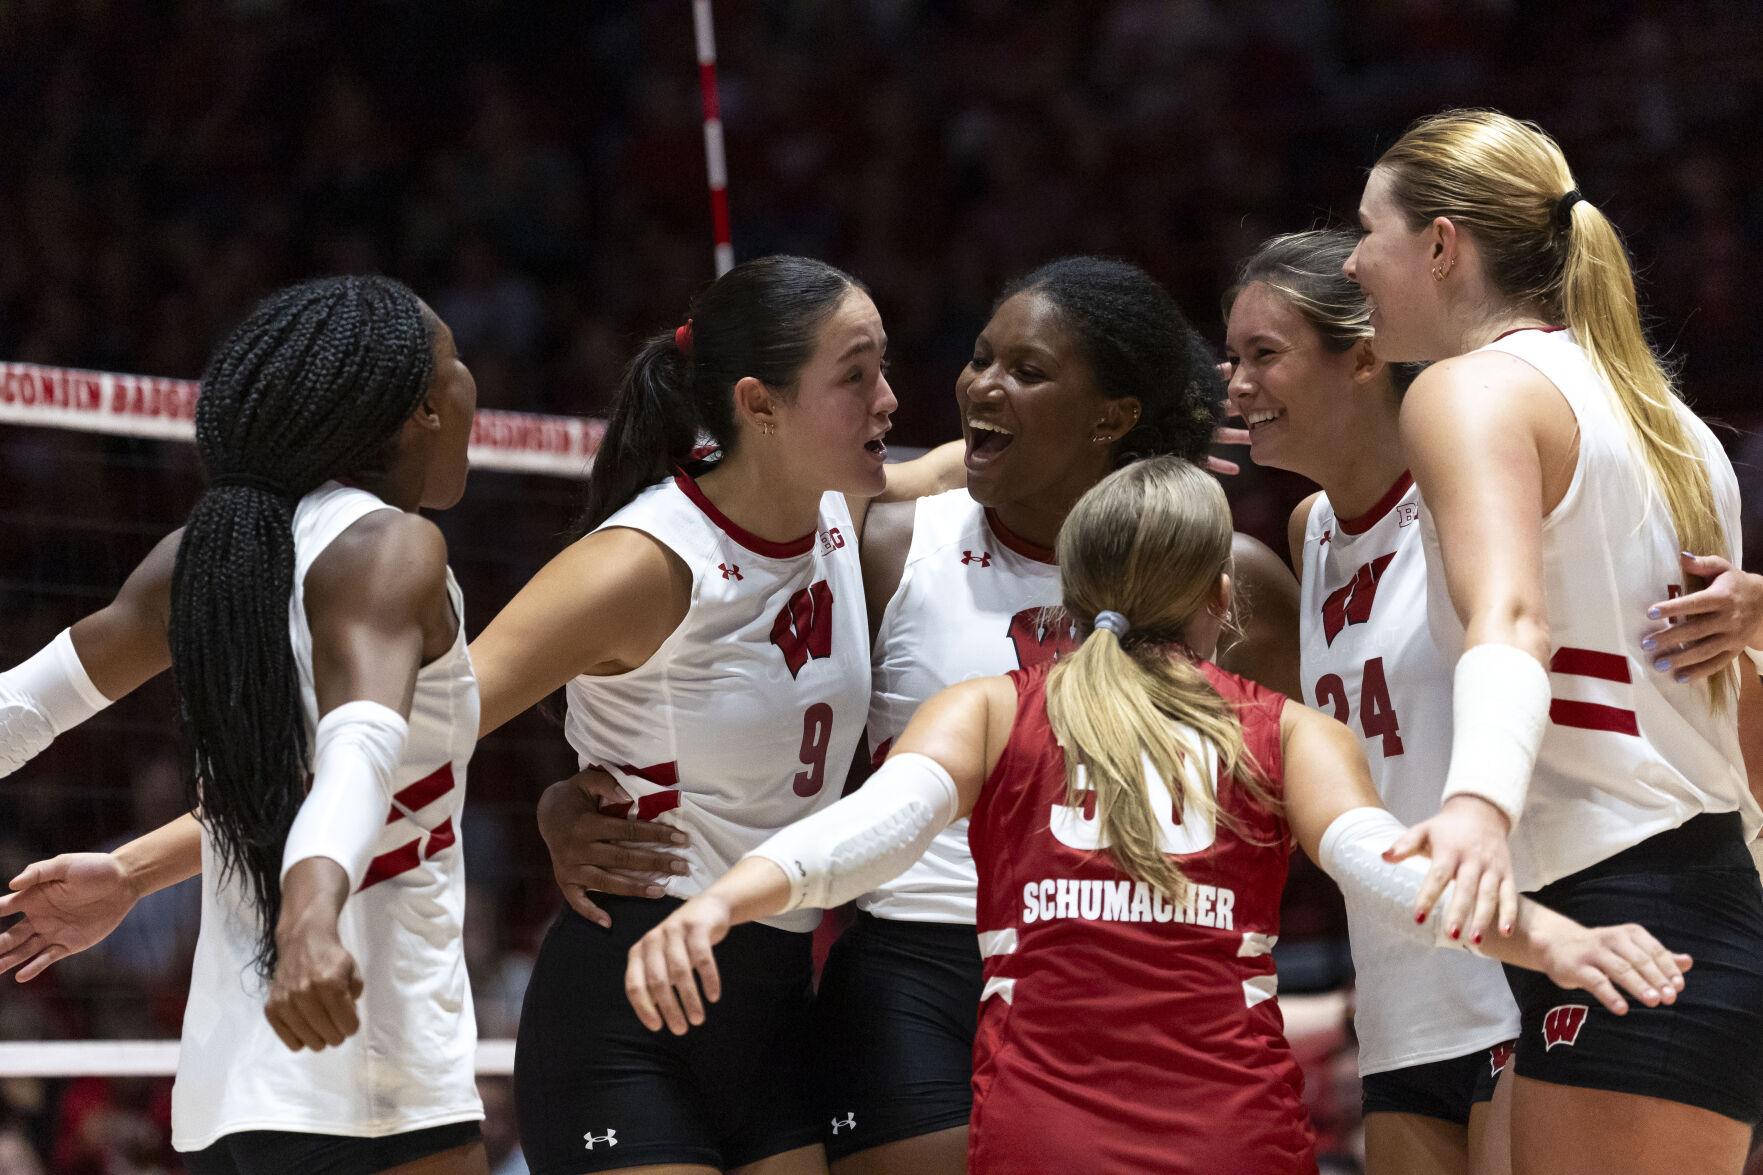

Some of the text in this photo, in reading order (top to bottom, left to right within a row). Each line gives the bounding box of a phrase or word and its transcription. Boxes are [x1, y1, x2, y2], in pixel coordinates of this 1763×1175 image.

[0, 370, 101, 411] CONSIN
[1315, 656, 1404, 758] 24
[793, 702, 834, 797] 9
[1023, 879, 1235, 931] SCHUMACHER
